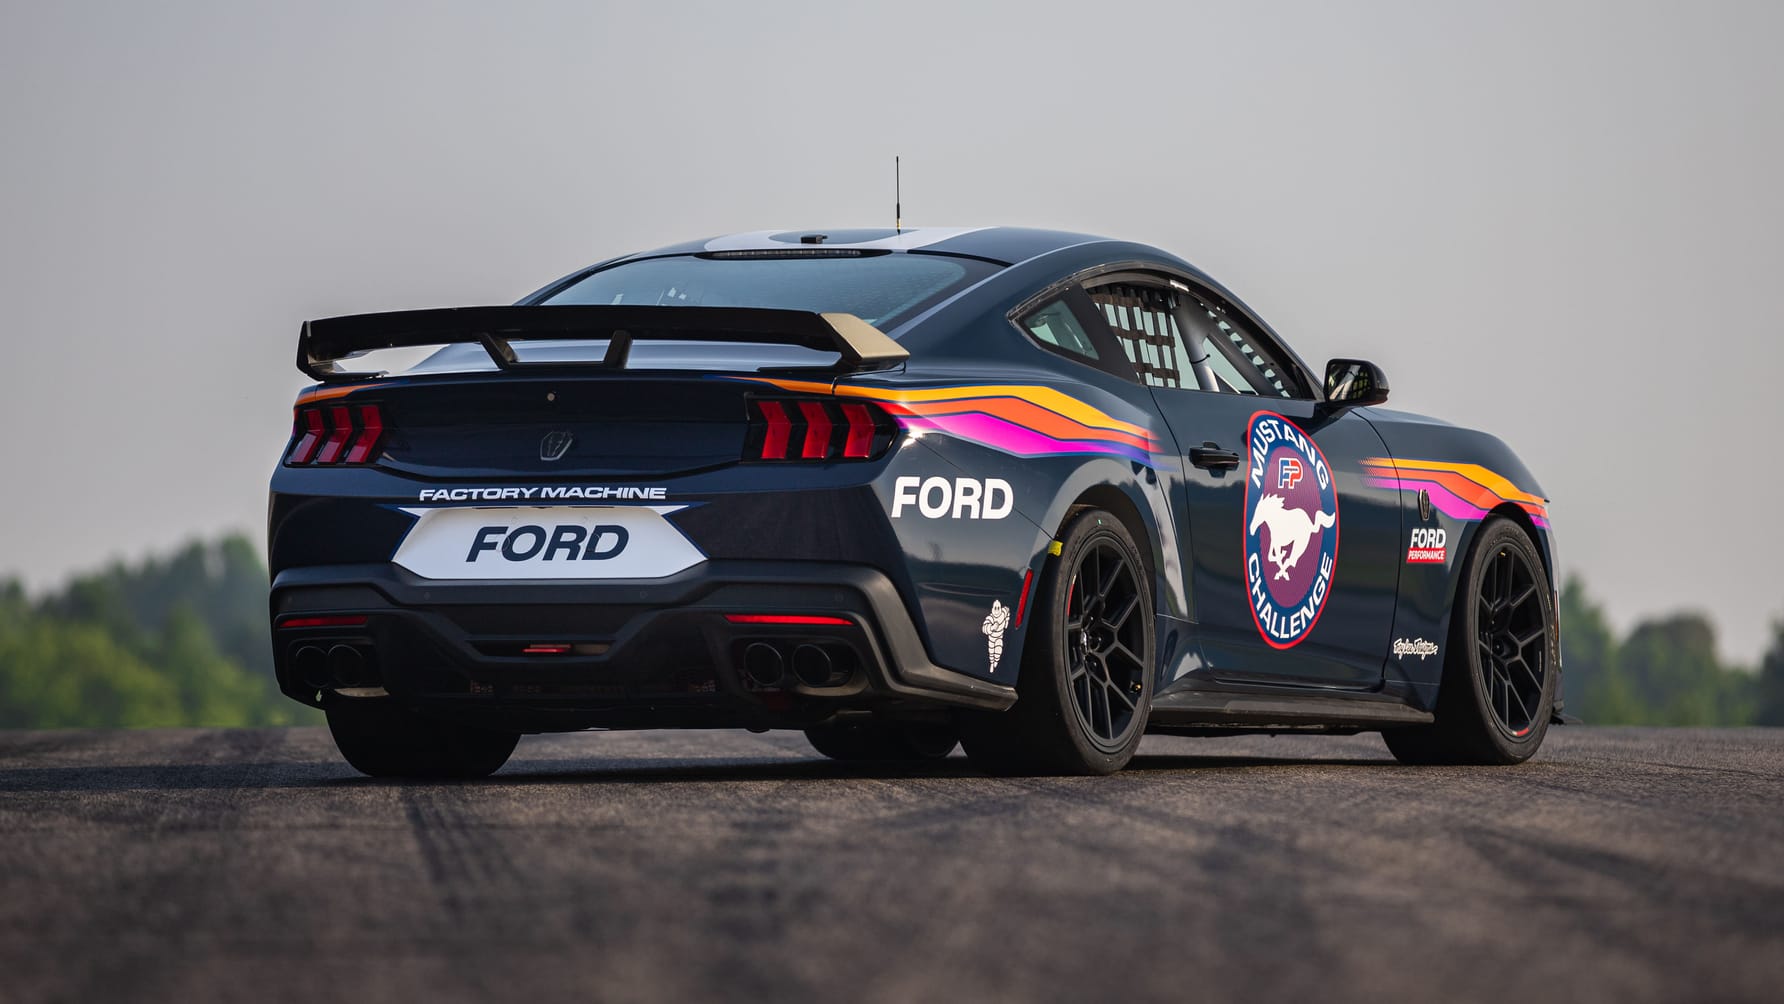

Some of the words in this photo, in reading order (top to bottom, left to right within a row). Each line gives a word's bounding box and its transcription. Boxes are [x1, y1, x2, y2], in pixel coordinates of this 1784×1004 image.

[1251, 419, 1329, 490] MUSTANG
[419, 487, 539, 502] FACTORY
[540, 487, 667, 500] MACHINE
[891, 476, 1014, 520] FORD
[466, 525, 630, 563] FORD
[1408, 549, 1445, 561] PERFORMANCE
[1410, 528, 1447, 549] FORD
[1248, 552, 1333, 639] CHALLENGE
